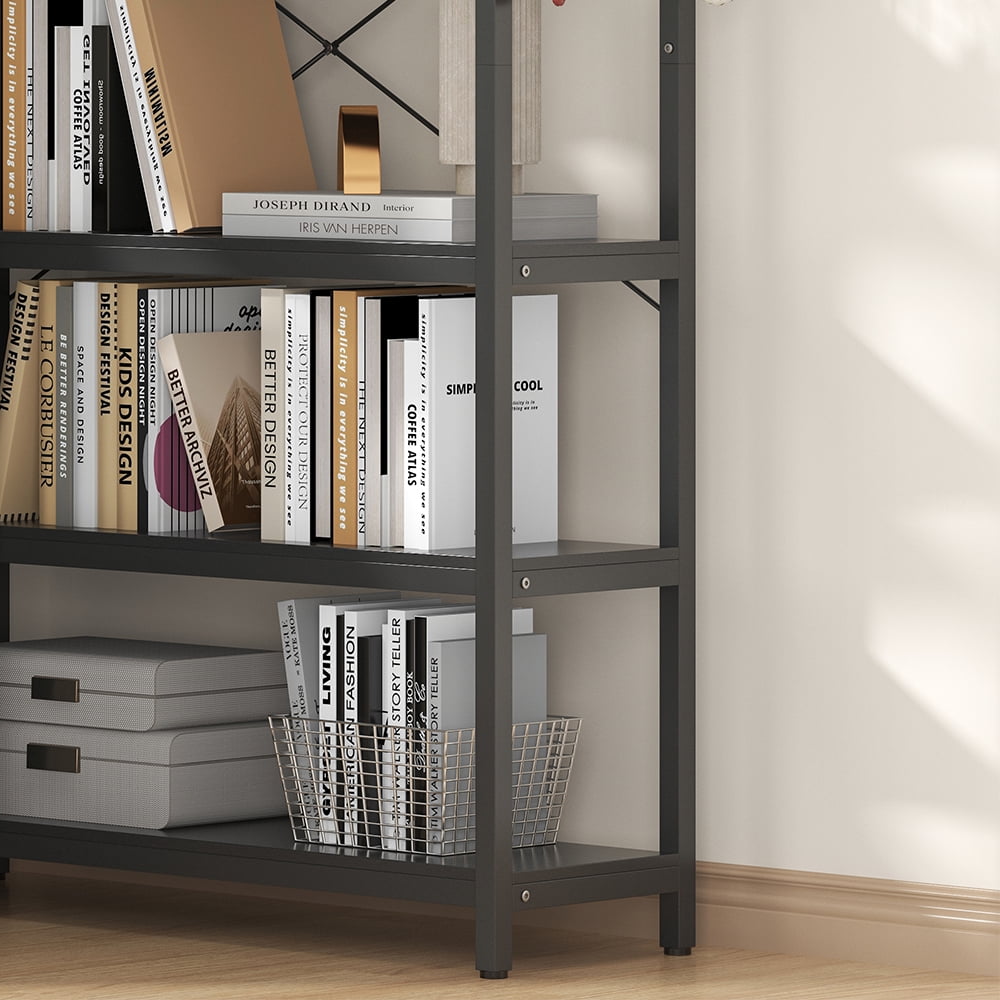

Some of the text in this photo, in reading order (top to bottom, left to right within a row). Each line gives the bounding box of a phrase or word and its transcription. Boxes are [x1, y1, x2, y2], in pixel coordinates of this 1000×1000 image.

[9, 65, 16, 74] is
[9, 81, 16, 92] in
[7, 98, 16, 167] everything
[74, 89, 82, 170] COFFEE ATLAS
[9, 172, 14, 188] we
[254, 200, 307, 210] JOSEPH
[315, 202, 370, 211] DIRAND
[300, 222, 398, 235] IRIS VAN HERPEN
[0, 293, 27, 411] DESIGN FESTIVAL
[61, 335, 66, 348] BE
[100, 293, 110, 416] DESIGN FESTIVAL
[338, 306, 347, 372] simplicity
[40, 326, 53, 488] LE CORBUSIER
[119, 348, 132, 484] KIDS DESIGN
[340, 377, 347, 387] is
[340, 393, 347, 405] in
[514, 380, 543, 391] COOL
[168, 369, 212, 499] BETTER ARCHVIZ
[265, 350, 276, 487] BETTER DESIGN
[338, 411, 347, 481] everything
[408, 404, 416, 485] COFFEE ATLAS
[340, 487, 345, 502] we
[322, 627, 331, 705] LIVING
[346, 626, 355, 710] FASHION
[392, 618, 400, 721] STORY TELLER
